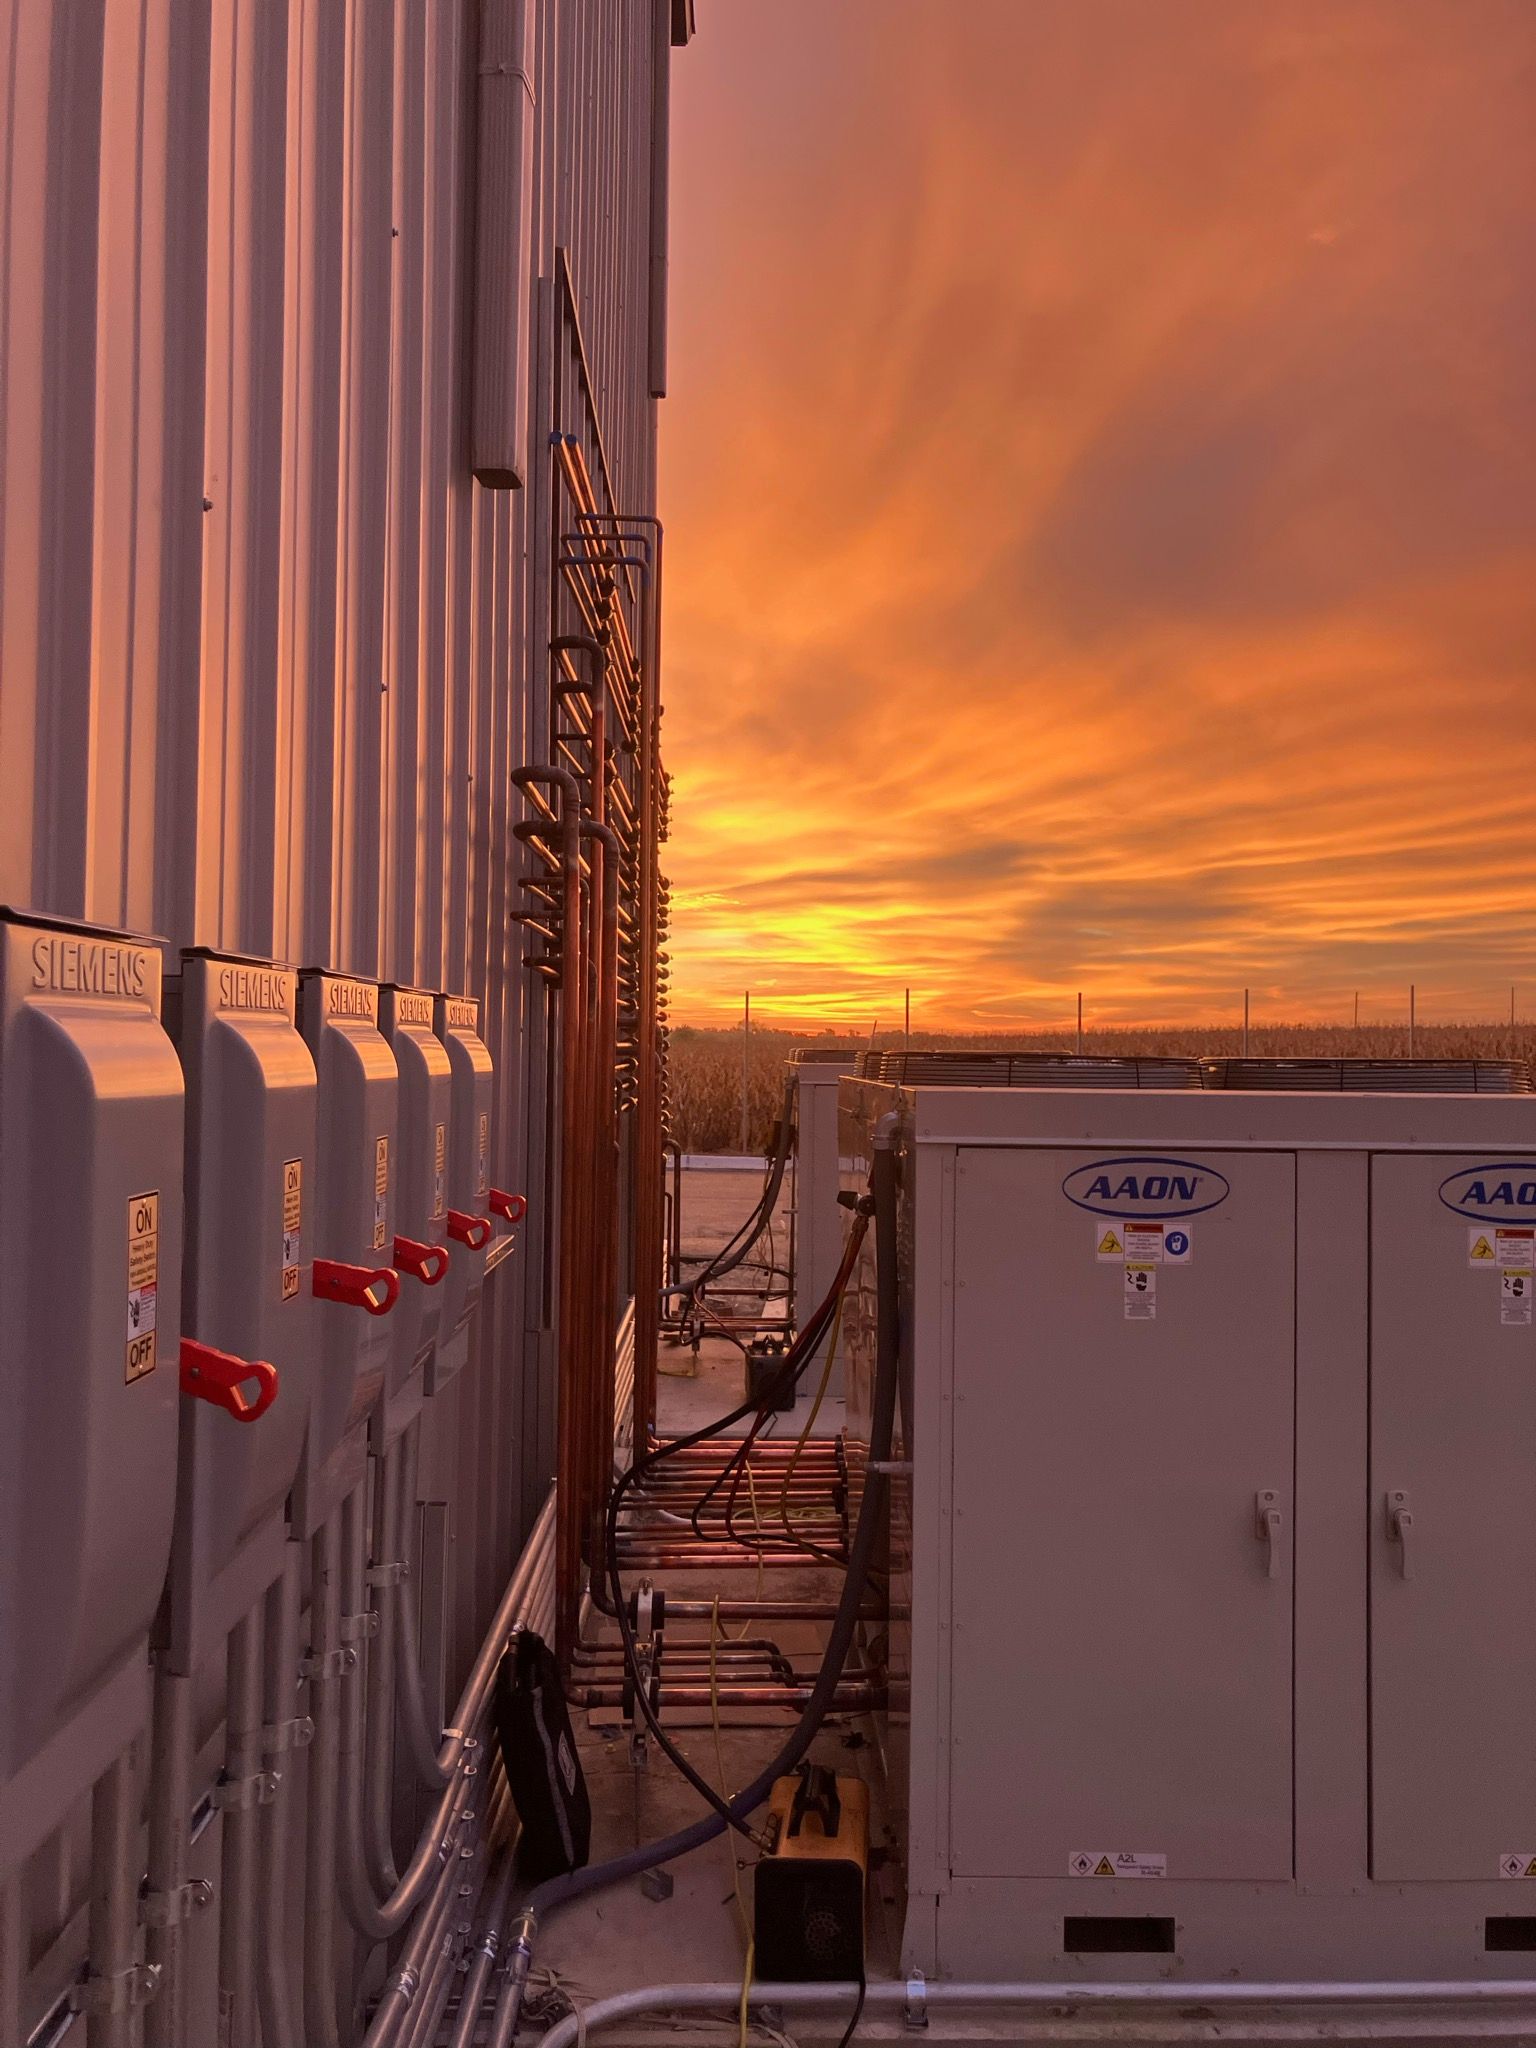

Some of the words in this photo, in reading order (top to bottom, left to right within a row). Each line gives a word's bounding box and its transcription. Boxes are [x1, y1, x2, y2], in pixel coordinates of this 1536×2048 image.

[32, 937, 146, 997] SIEMENS
[220, 968, 286, 1009] SIEMENS
[330, 983, 373, 1016] SIEMENS
[400, 997, 430, 1022] SIEMENS
[450, 1004, 475, 1025] SIEMENS
[288, 1169, 298, 1189] ON
[1083, 1176, 1198, 1200] AAON
[136, 1207, 152, 1233] ON
[284, 1268, 297, 1289] OFF
[130, 1337, 152, 1368] OFF
[1117, 1853, 1136, 1863] A2L
